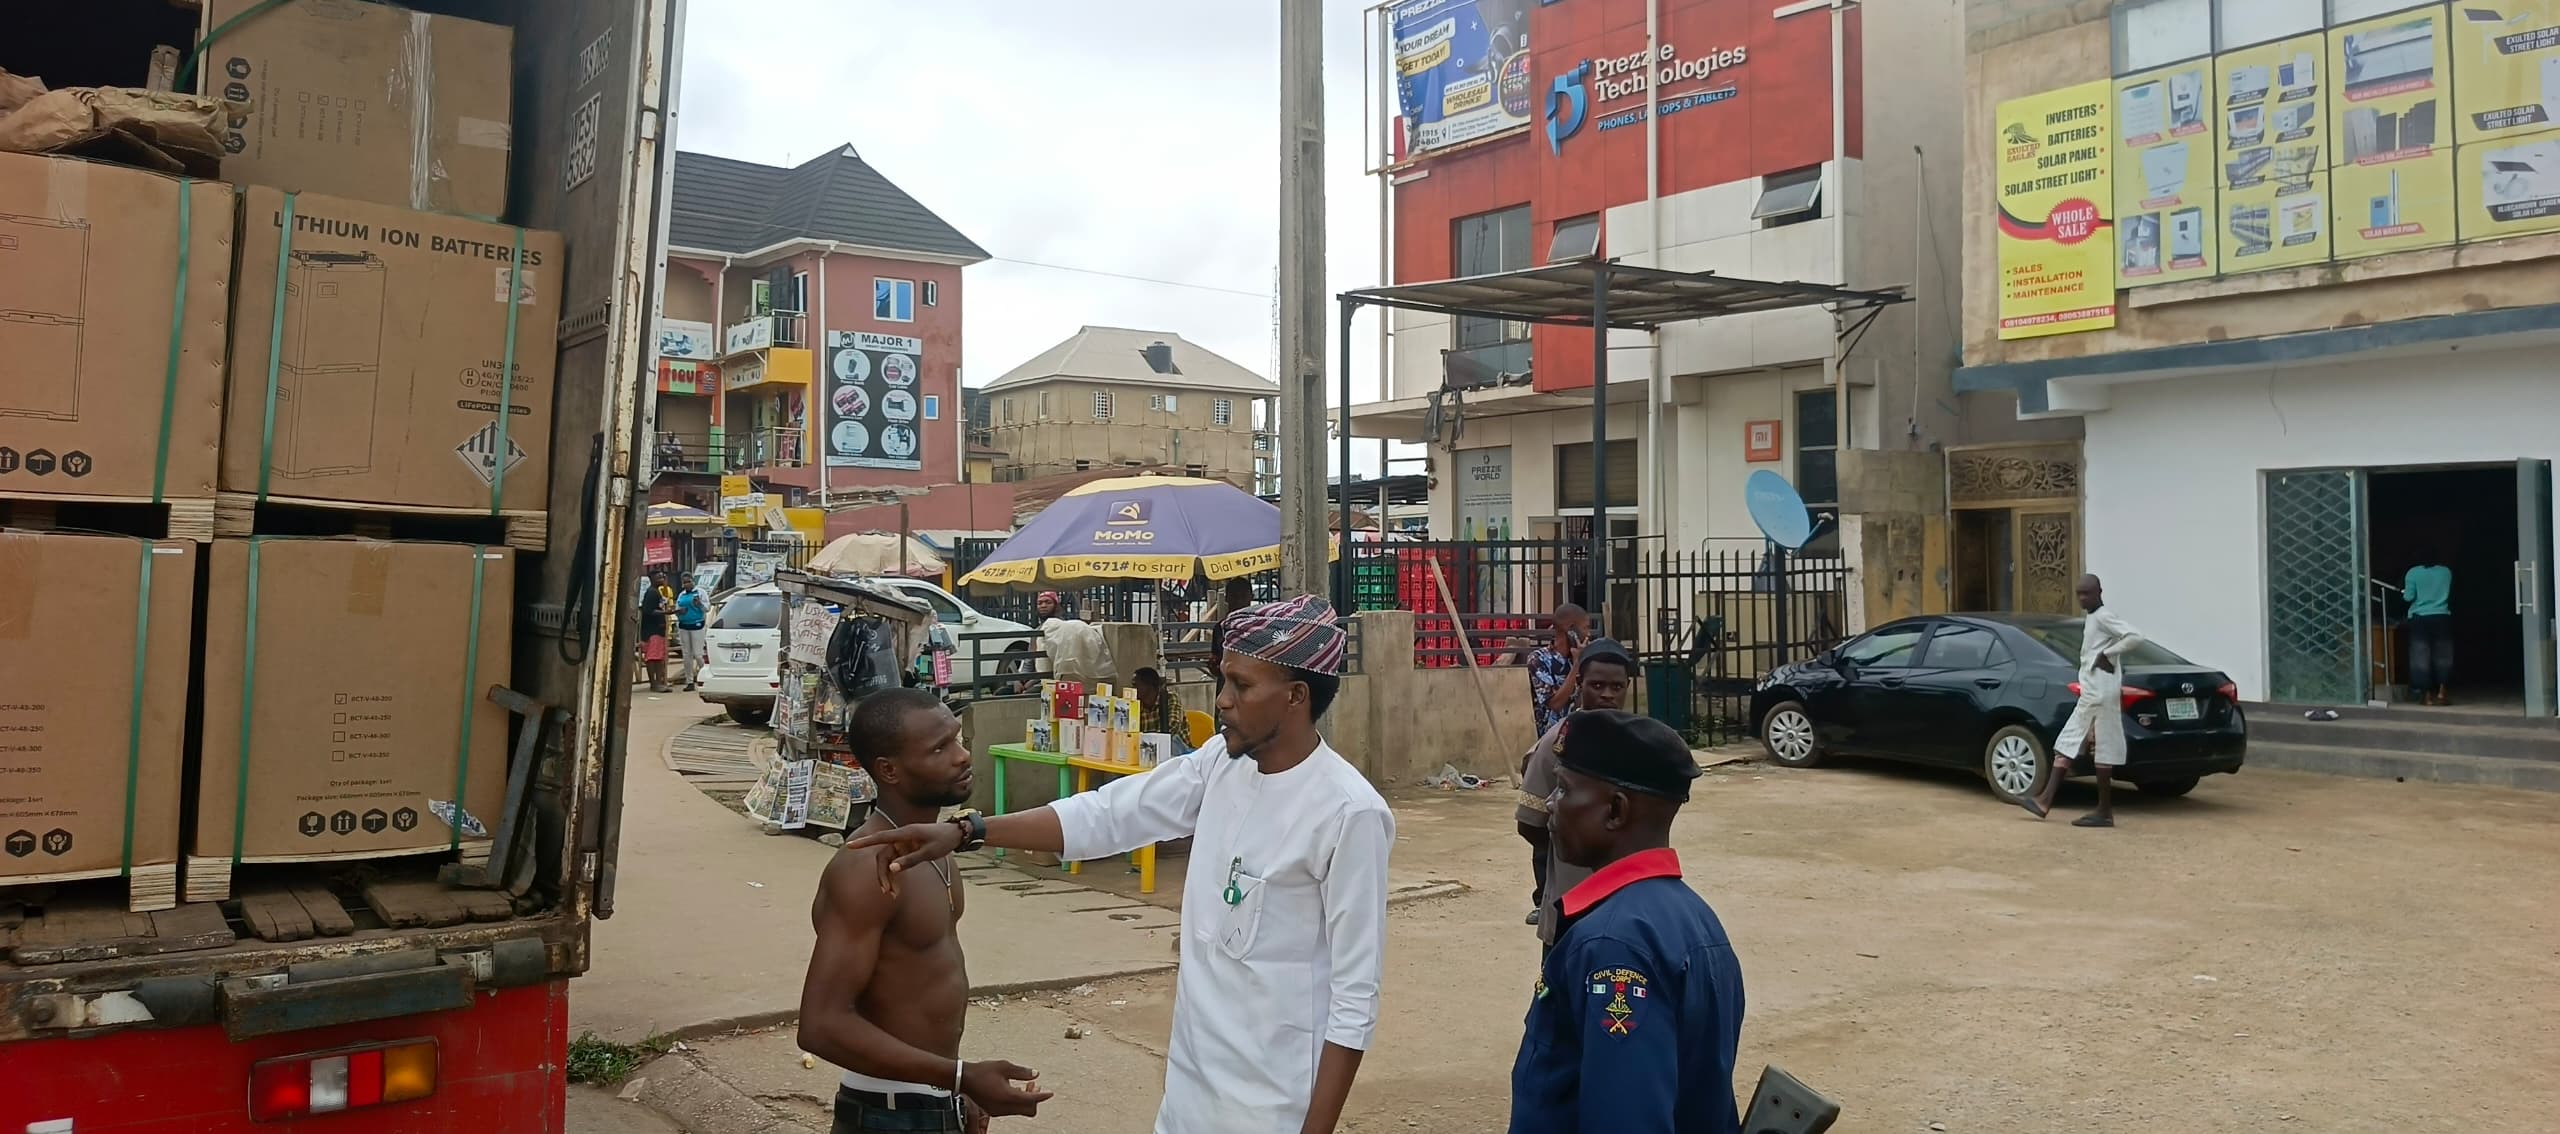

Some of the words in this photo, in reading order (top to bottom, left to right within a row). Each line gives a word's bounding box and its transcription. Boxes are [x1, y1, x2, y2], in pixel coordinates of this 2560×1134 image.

[2509, 41, 2534, 53] STREET
[2536, 34, 2556, 48] LIGHT
[1402, 58, 1419, 72] GET
[1594, 43, 1674, 81] Prezze
[1446, 84, 1489, 105] WHOLESALE
[1639, 100, 1681, 122] LATOPS
[1683, 97, 1692, 109] &
[2046, 104, 2097, 126] INVERTERS
[2511, 114, 2532, 125] LIGHT
[2047, 125, 2097, 147] BATTERIES
[2037, 152, 2067, 170] SOLAR
[2069, 146, 2097, 163] PANEL
[2004, 180, 2034, 197] SOLAR
[2035, 173, 2069, 191] STREET
[2070, 167, 2098, 185] LIGHT
[2051, 206, 2093, 226] WHOLE
[273, 211, 369, 241] LTHIUM
[380, 227, 420, 249] ION
[431, 235, 543, 266] BATTERIES
[2058, 222, 2087, 239] SALE
[2012, 263, 2043, 275] SALES
[2013, 270, 2083, 288] INSTALLATION
[2013, 283, 2085, 299] MAINTENANCE
[861, 334, 903, 347] MAJOR
[907, 338, 913, 347] 1
[1094, 530, 1155, 541] MoMo
[1053, 561, 1080, 574] Dial
[1132, 561, 1148, 573] to
[1151, 560, 1187, 574] start
[1210, 560, 1233, 574] Dial
[1593, 969, 1612, 980] CIVIL
[1616, 969, 1648, 985] DEFENCE
[1610, 975, 1631, 983] CORPS
